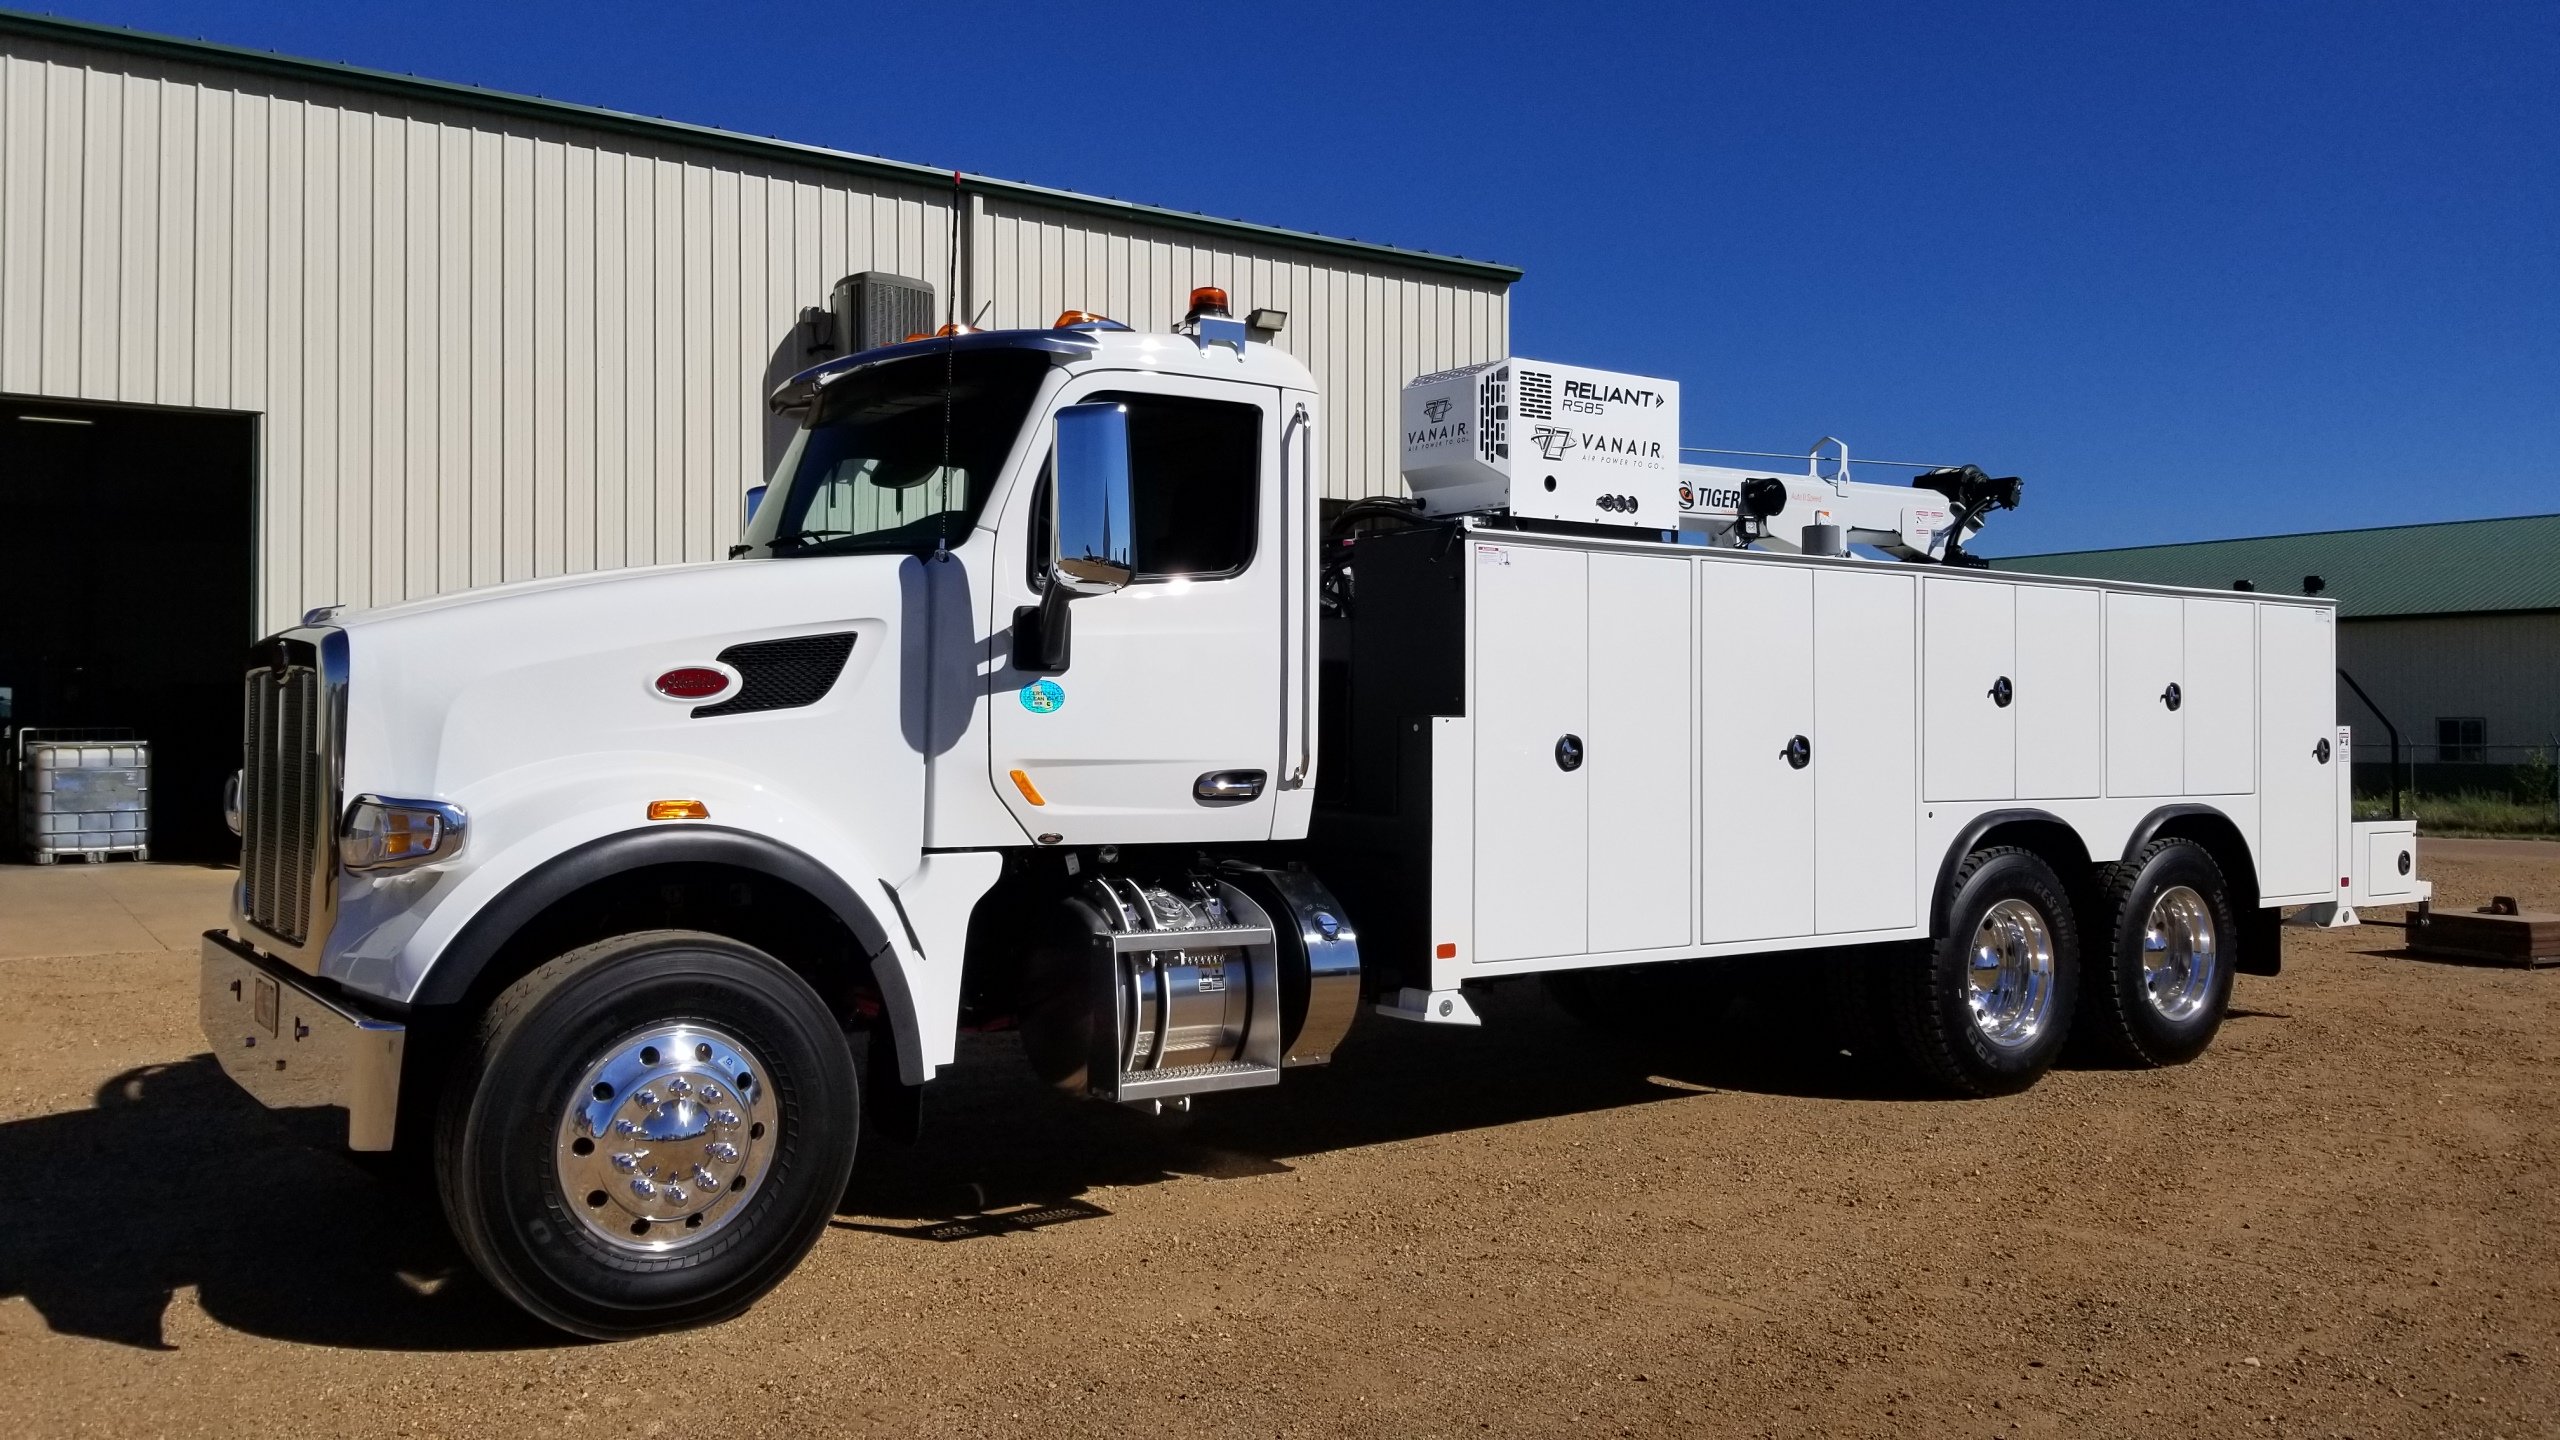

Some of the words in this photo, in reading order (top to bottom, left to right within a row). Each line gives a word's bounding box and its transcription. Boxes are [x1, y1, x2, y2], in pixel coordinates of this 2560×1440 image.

[1563, 380, 1654, 408] RELIANT
[1562, 399, 1605, 416] RS85
[1408, 422, 1466, 445] VANAIR
[1582, 432, 1661, 459] VANAIR
[1698, 487, 1741, 509] TIGER
